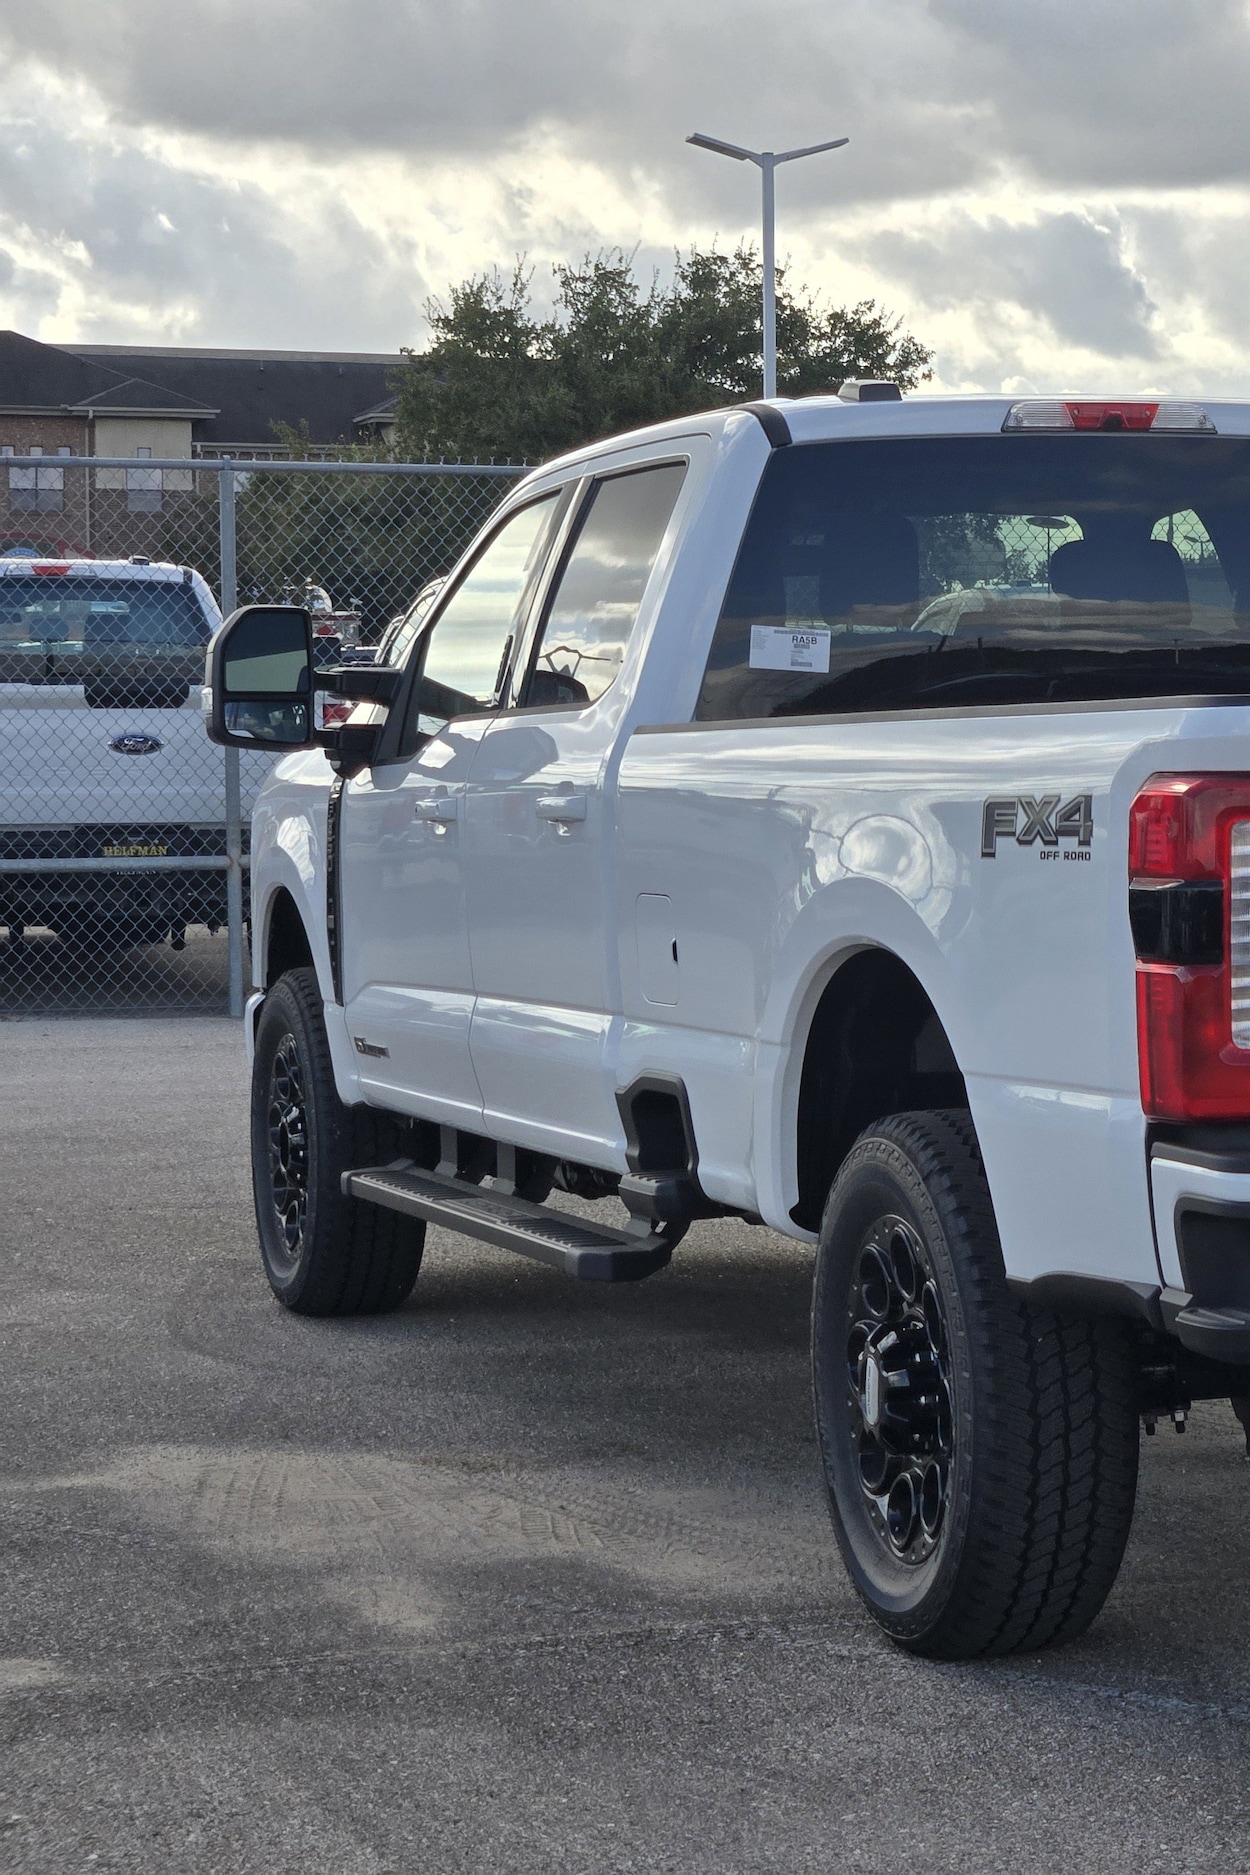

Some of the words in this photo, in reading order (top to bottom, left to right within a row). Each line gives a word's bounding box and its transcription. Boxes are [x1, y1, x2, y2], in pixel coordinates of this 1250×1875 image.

[792, 635, 817, 645] RA5B
[981, 794, 1093, 858] FX4
[103, 845, 168, 857] HELFMAN
[1040, 850, 1060, 861] OFF
[1063, 851, 1092, 861] ROAD
